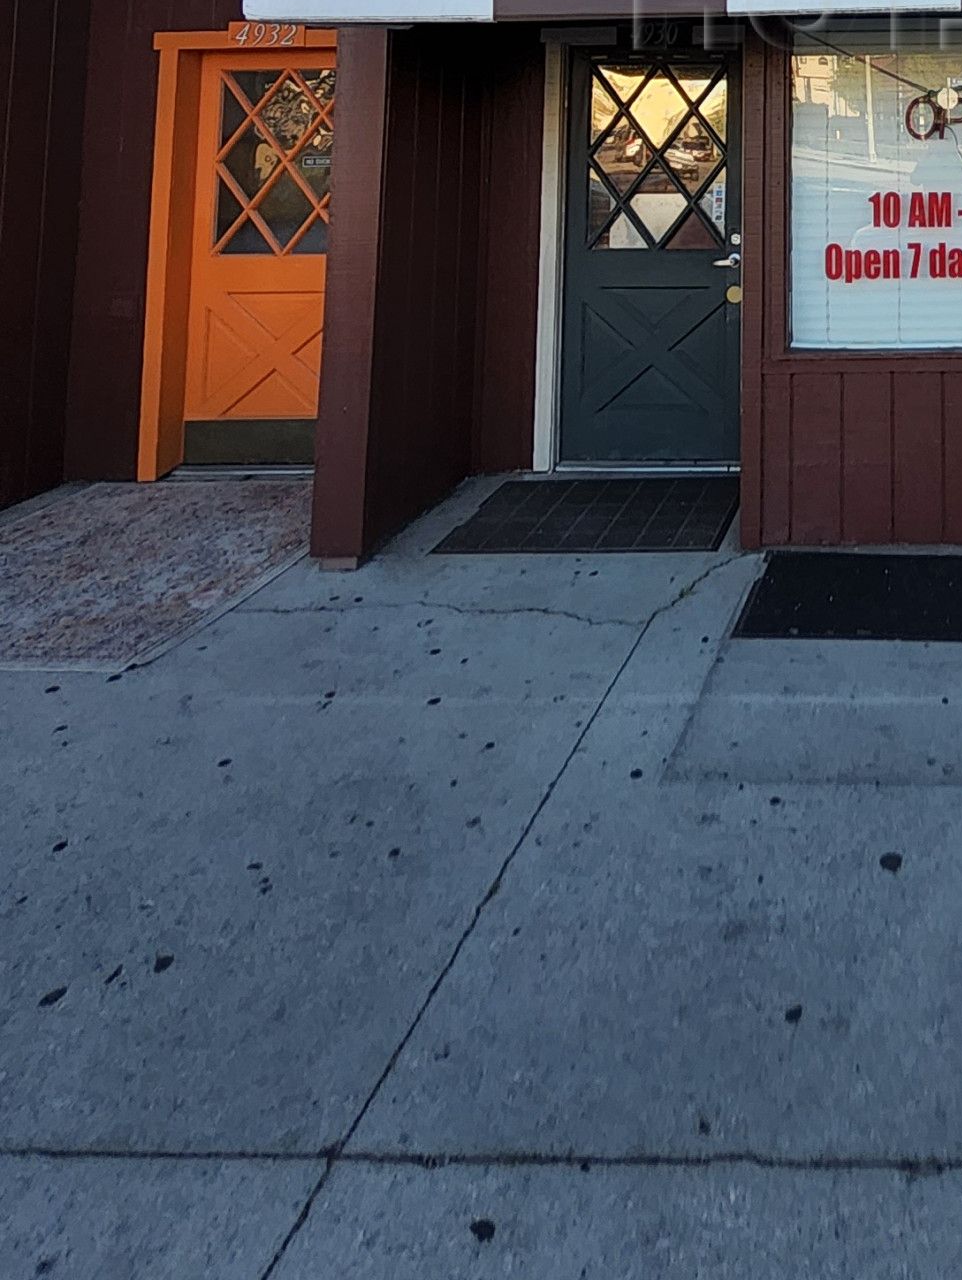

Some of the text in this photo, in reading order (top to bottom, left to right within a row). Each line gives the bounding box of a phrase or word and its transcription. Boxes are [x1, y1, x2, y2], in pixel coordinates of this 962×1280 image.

[235, 23, 297, 46] 4932
[868, 191, 900, 228] 10
[907, 191, 951, 228] AM
[824, 242, 900, 284] Open
[907, 243, 922, 279] 7
